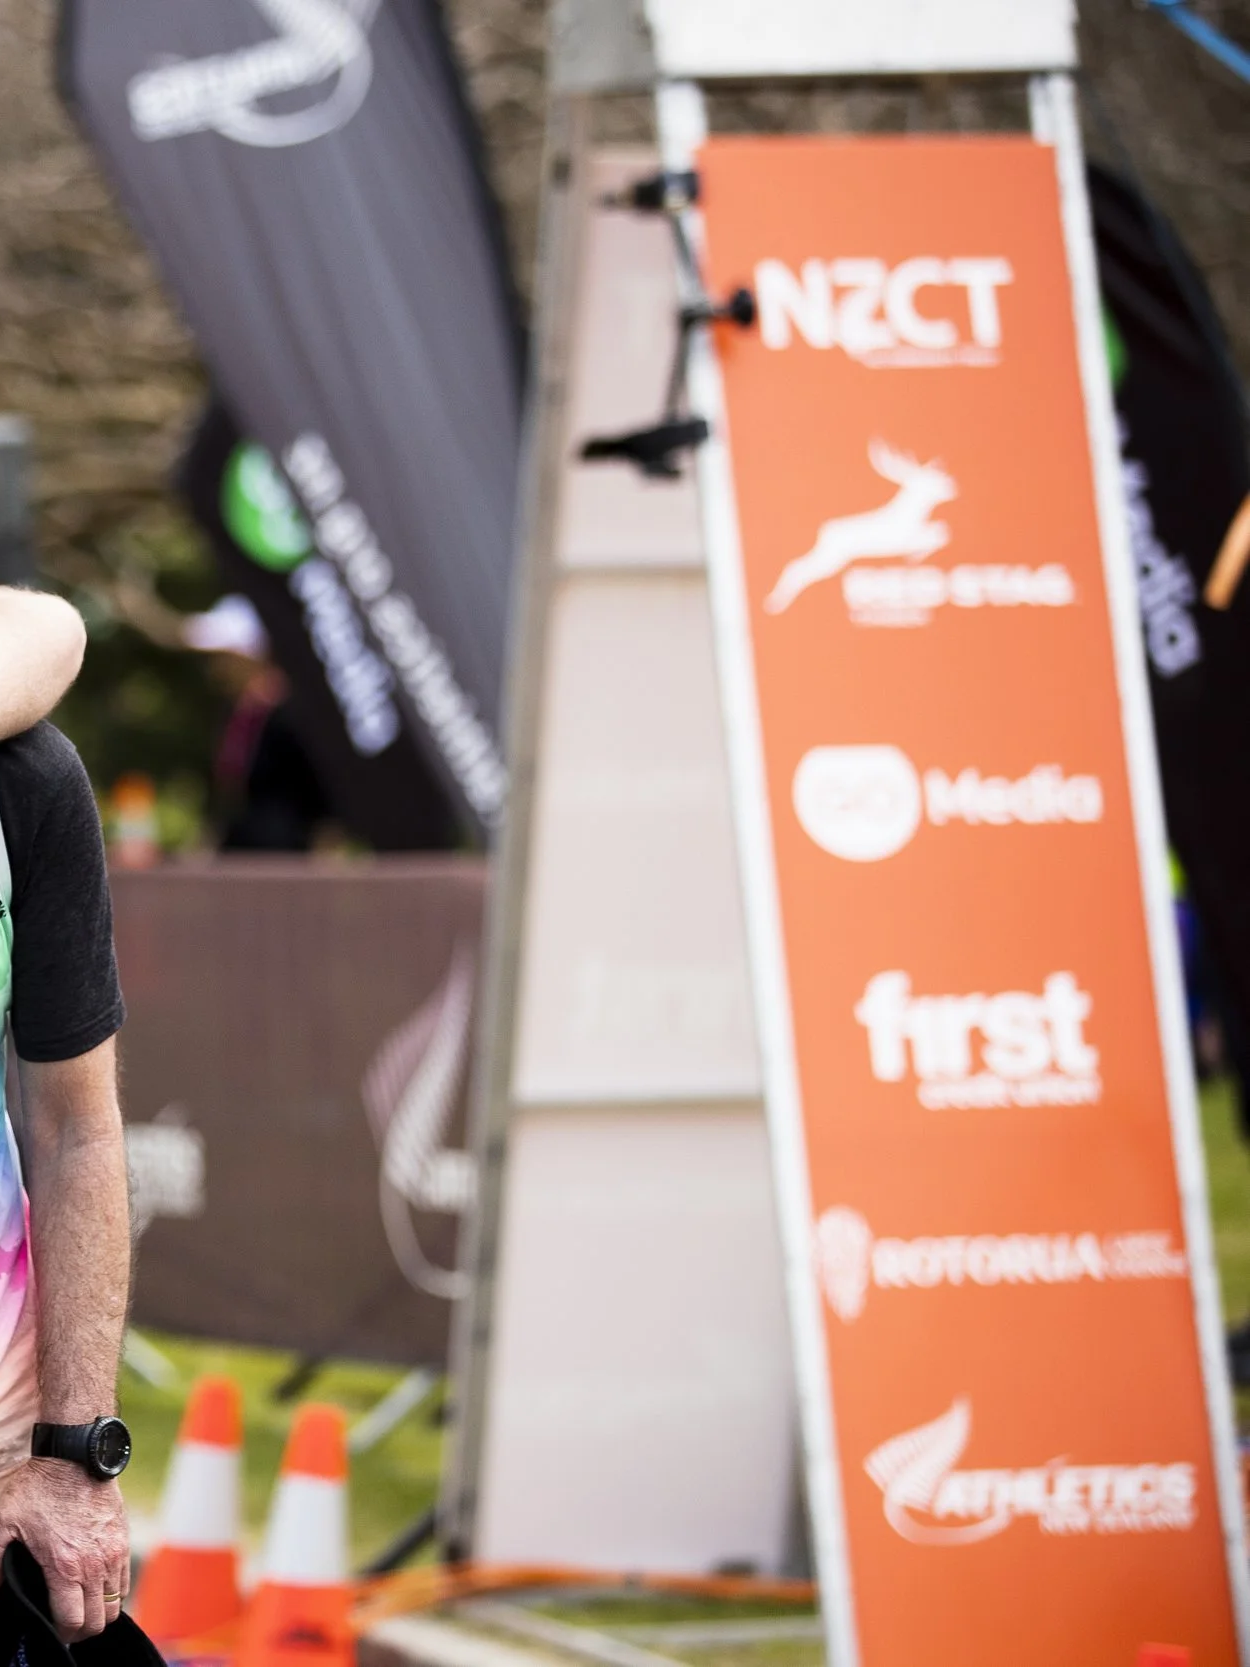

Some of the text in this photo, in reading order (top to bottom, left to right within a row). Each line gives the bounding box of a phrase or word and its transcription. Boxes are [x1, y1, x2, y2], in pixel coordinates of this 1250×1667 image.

[754, 256, 1013, 350] NZCT
[923, 764, 1104, 826] Media
[854, 970, 1099, 1081] first
[872, 1234, 1105, 1288] ROTORUA
[933, 1462, 1196, 1519] ATHLETICS
